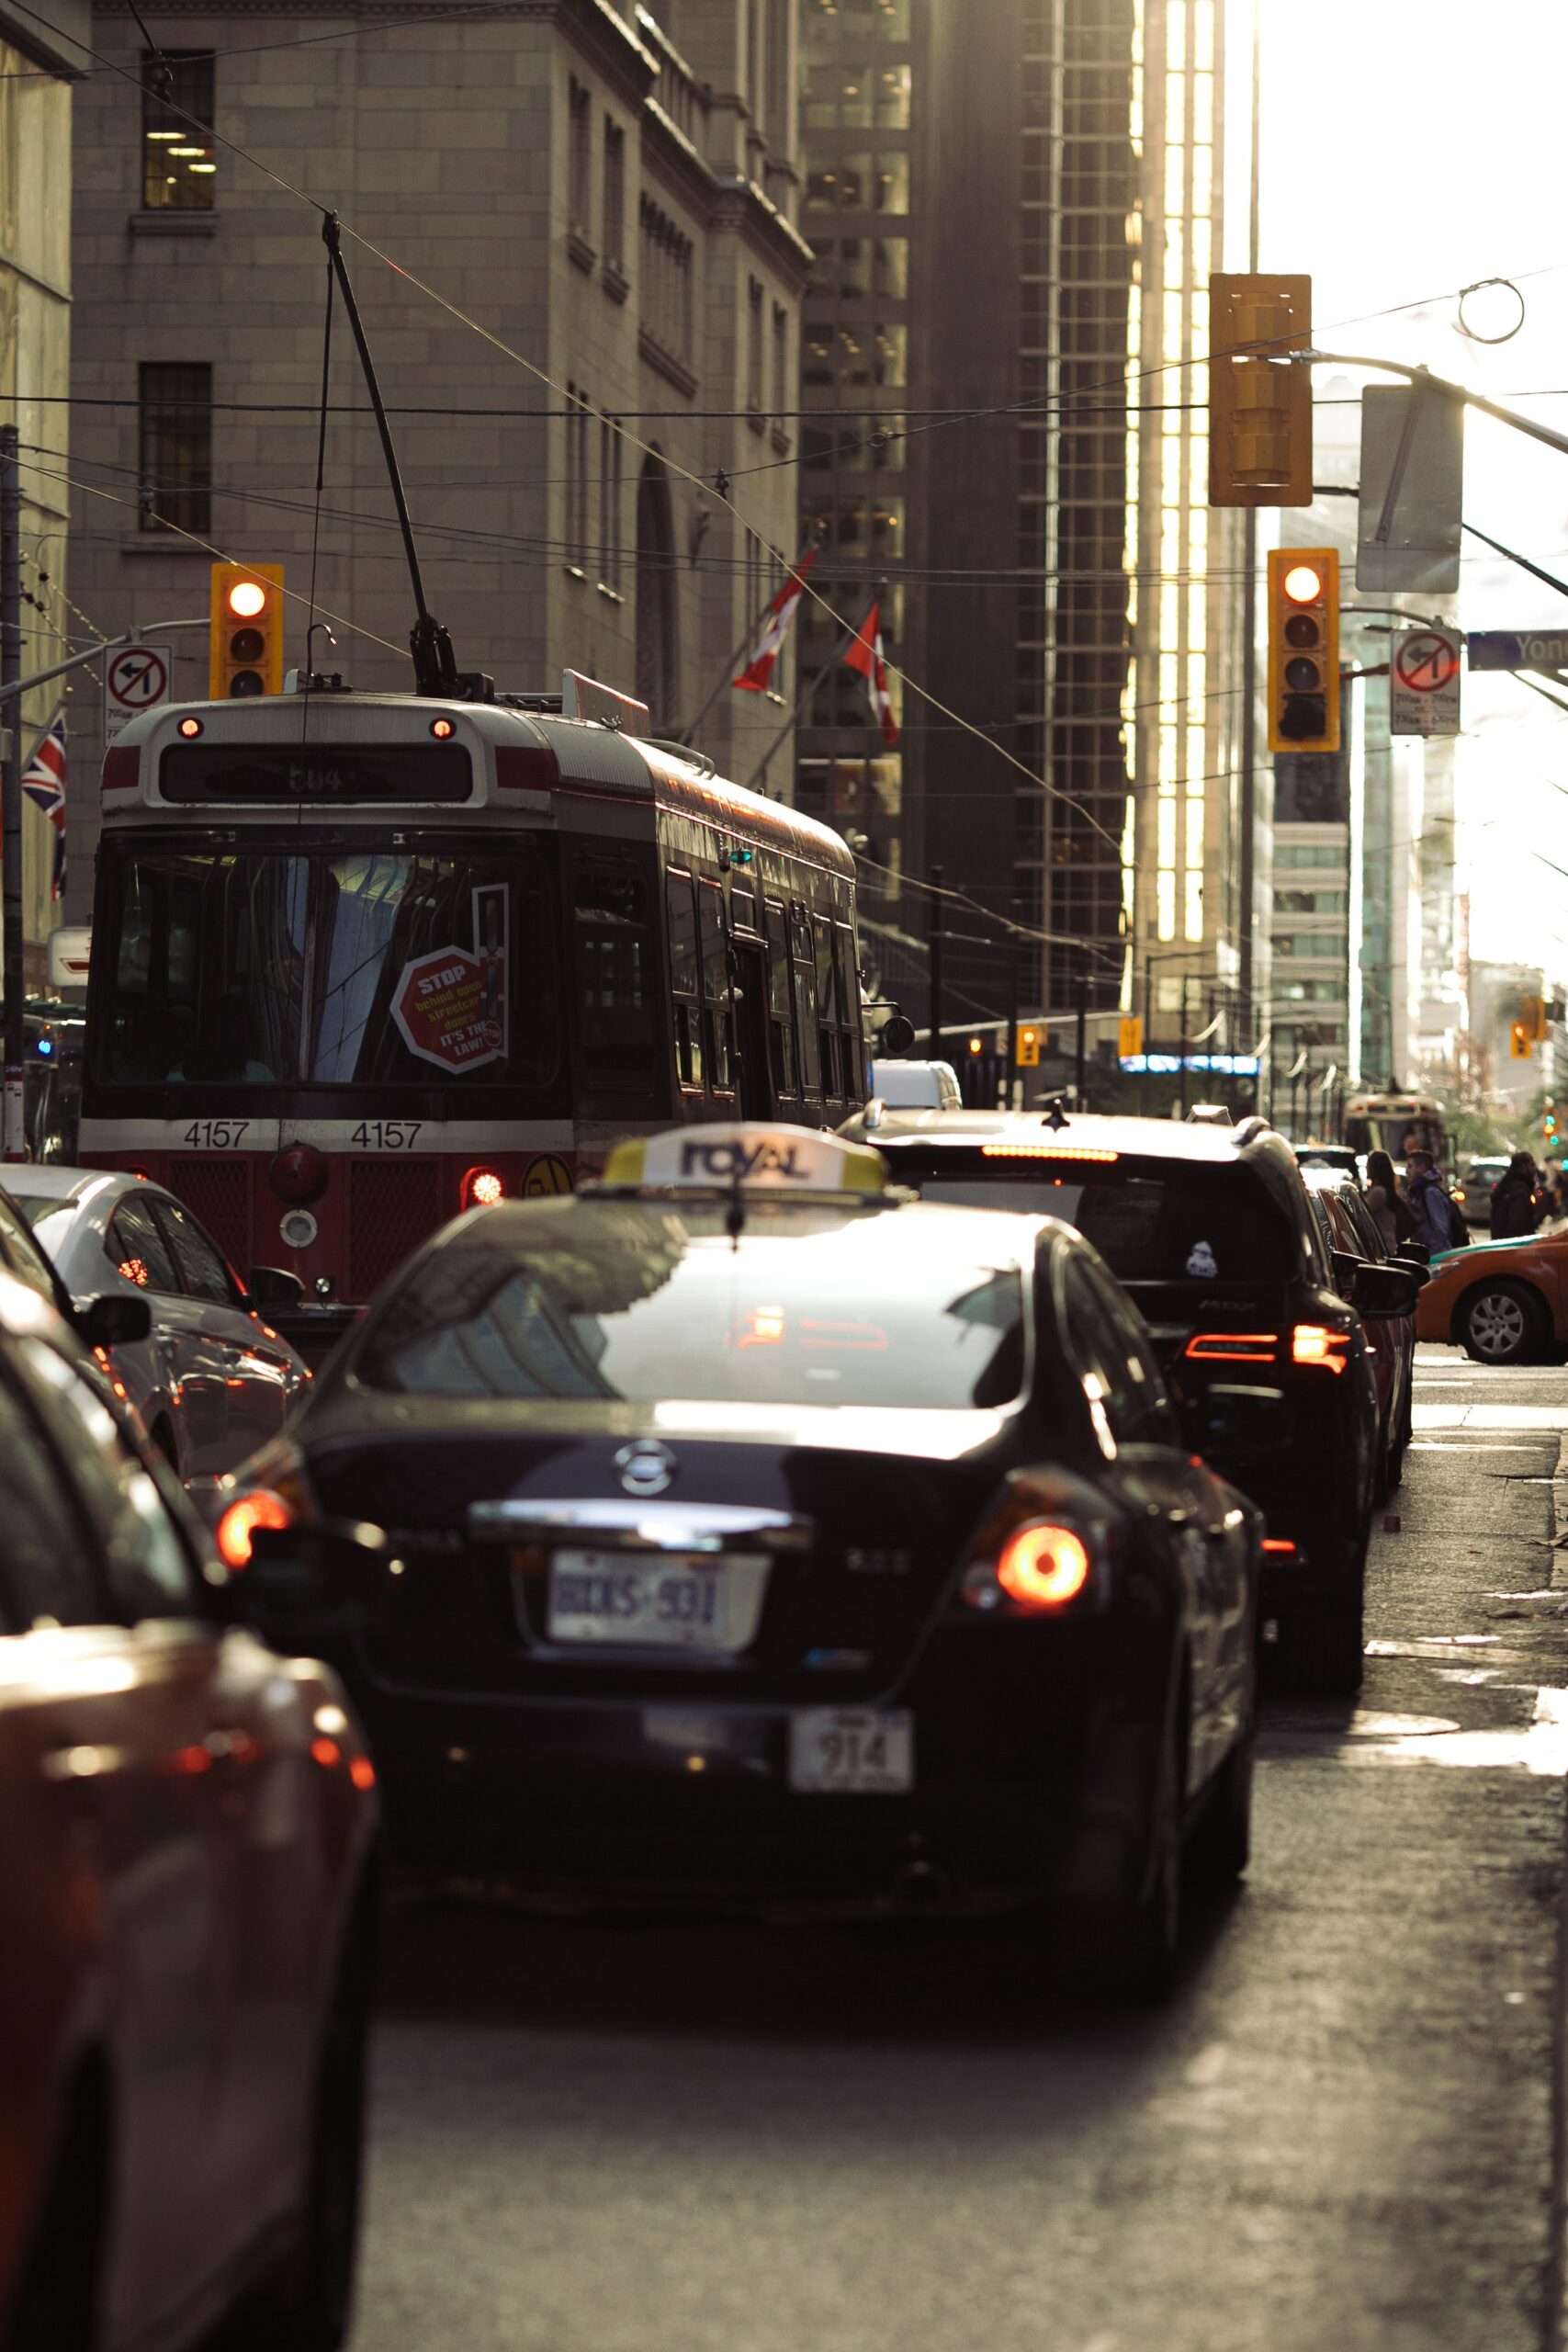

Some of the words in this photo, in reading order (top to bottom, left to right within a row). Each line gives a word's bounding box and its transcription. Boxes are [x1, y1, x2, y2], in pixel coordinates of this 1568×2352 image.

[1515, 635, 1568, 662] Yon
[417, 965, 466, 994] STOP
[415, 990, 454, 1012] behind
[457, 981, 482, 996] open
[428, 997, 479, 1022] streetcar
[445, 1013, 476, 1030] doors
[440, 1029, 465, 1047] IT'S
[454, 1037, 483, 1057] LAW!
[184, 1121, 250, 1148] 4157
[351, 1122, 422, 1148] 4157
[818, 1732, 886, 1773] 914
